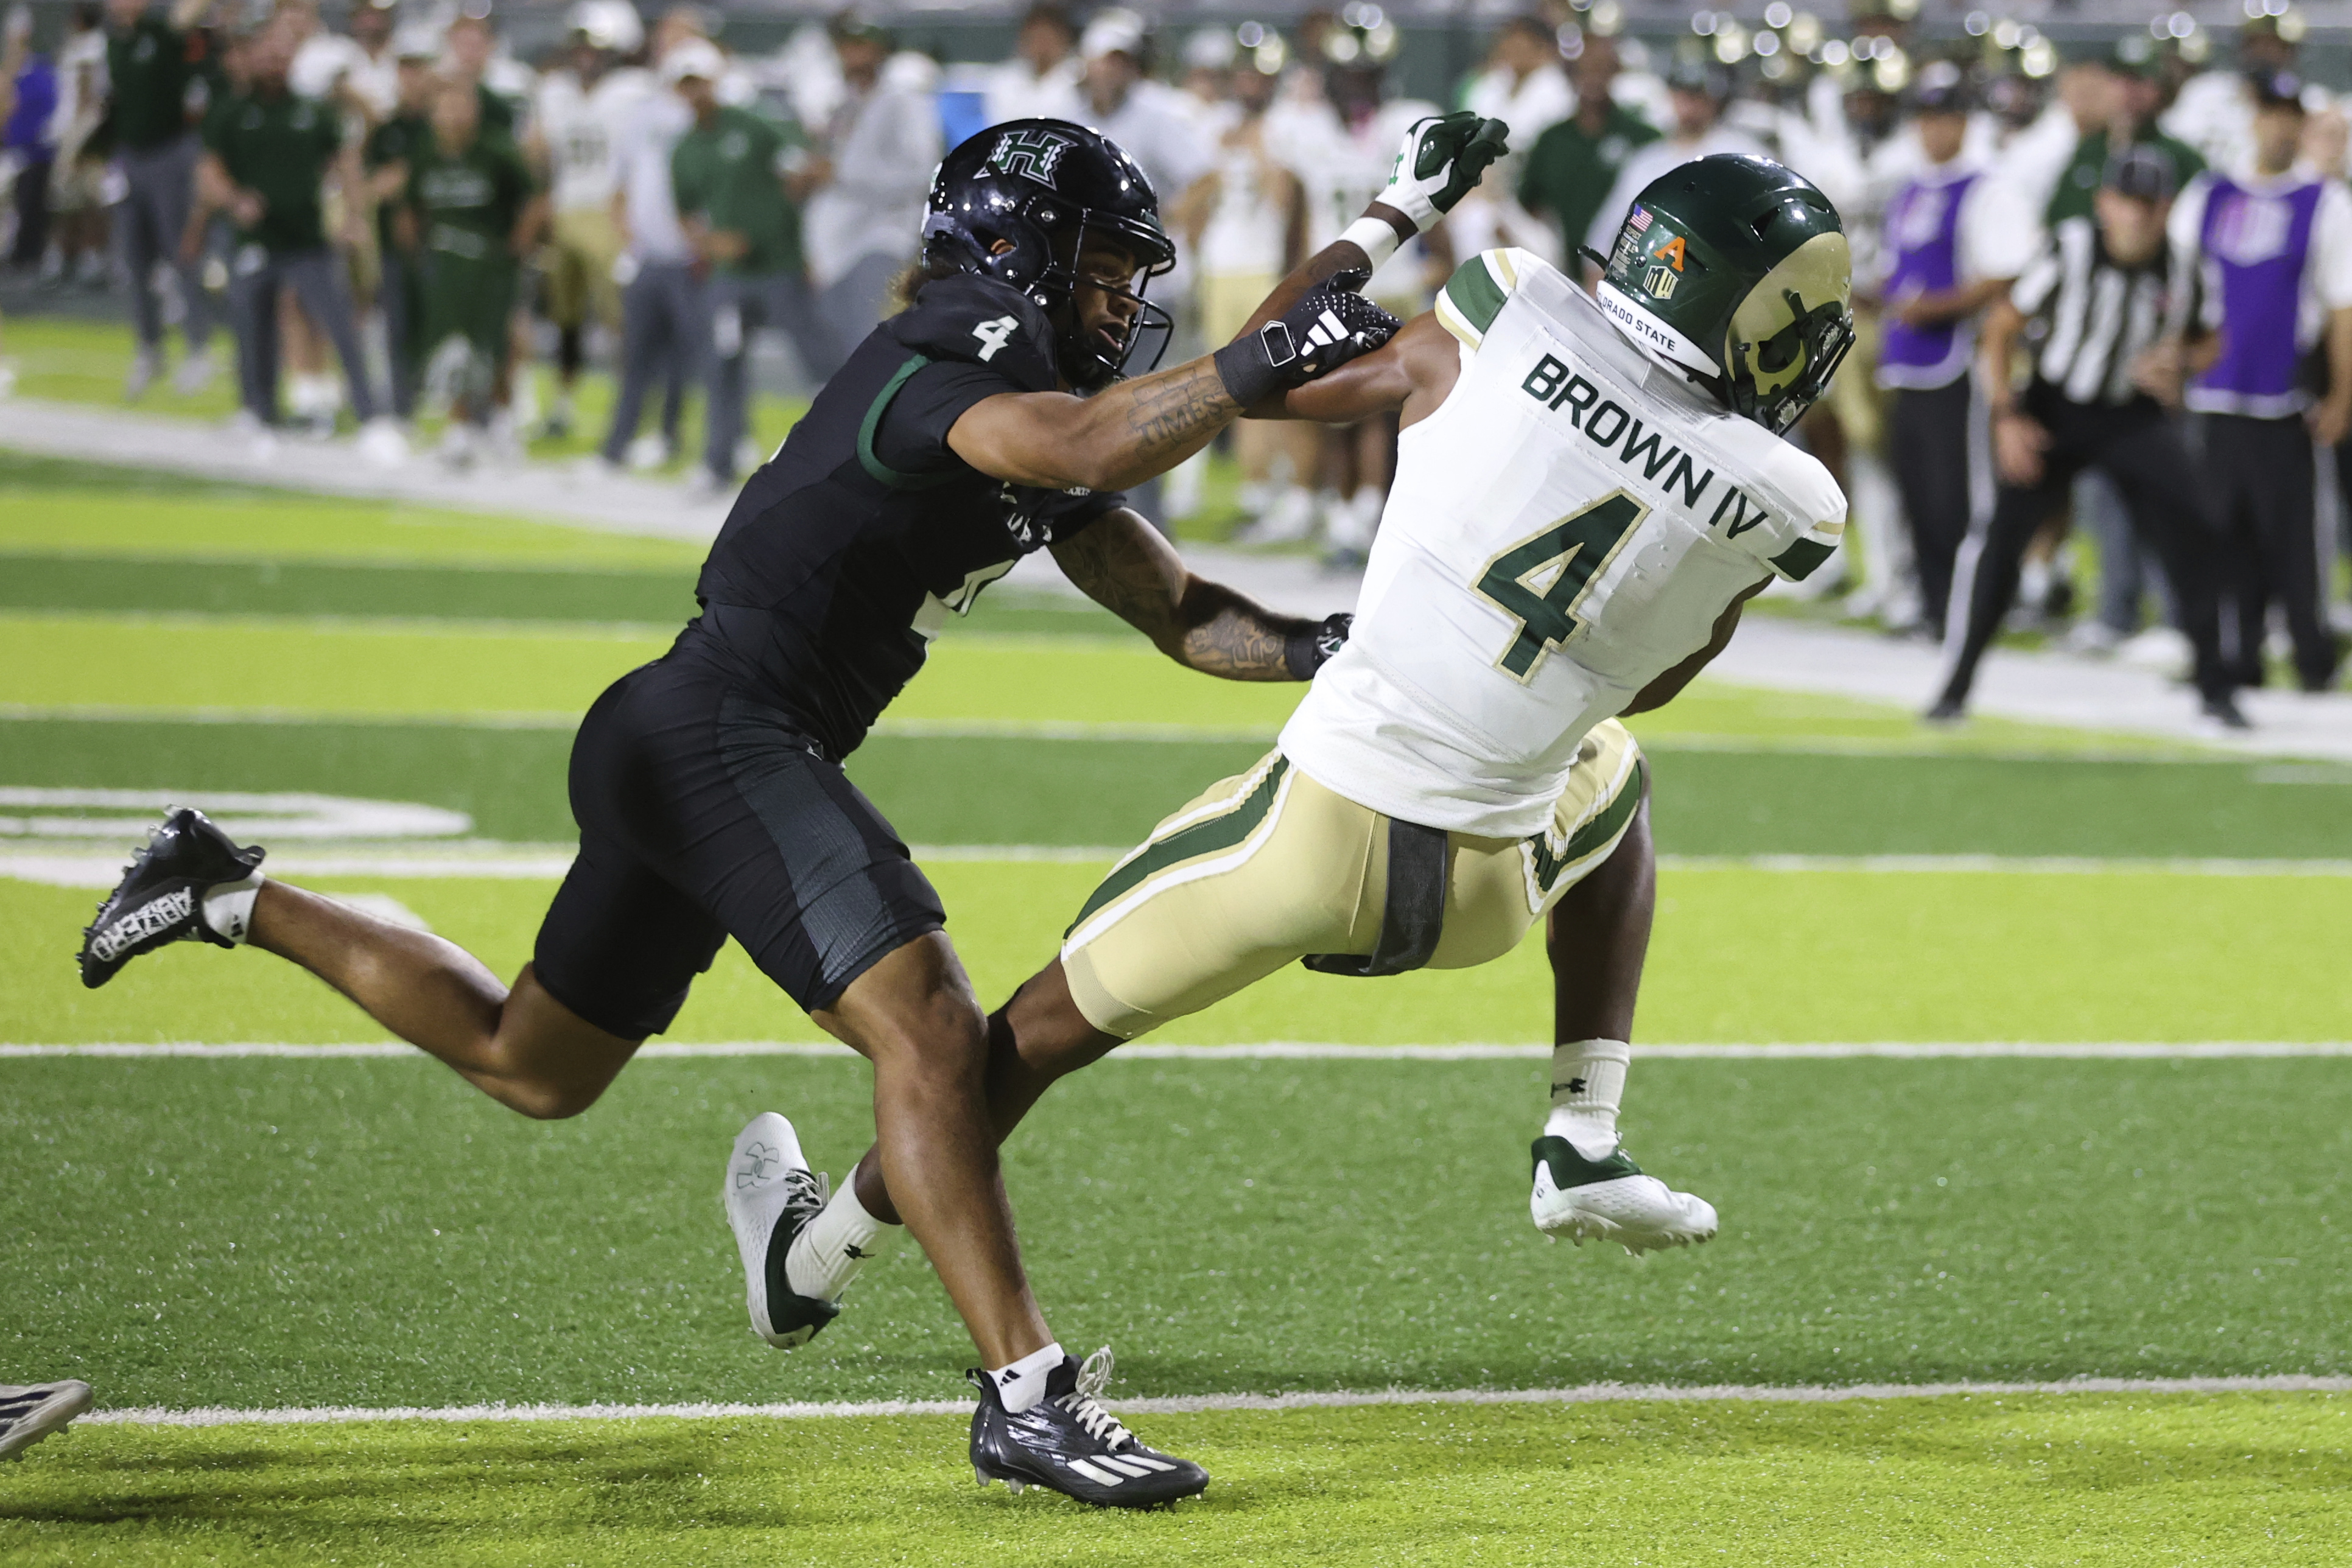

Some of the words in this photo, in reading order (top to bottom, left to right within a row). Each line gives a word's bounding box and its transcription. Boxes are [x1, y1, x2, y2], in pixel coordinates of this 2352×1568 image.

[974, 130, 1079, 191] H
[1653, 236, 1687, 272] A
[972, 315, 1020, 362] 4
[1635, 320, 1676, 352] STATE
[1522, 352, 1715, 509] BROWN
[1708, 485, 1769, 540] IV
[1468, 487, 1652, 686] 4
